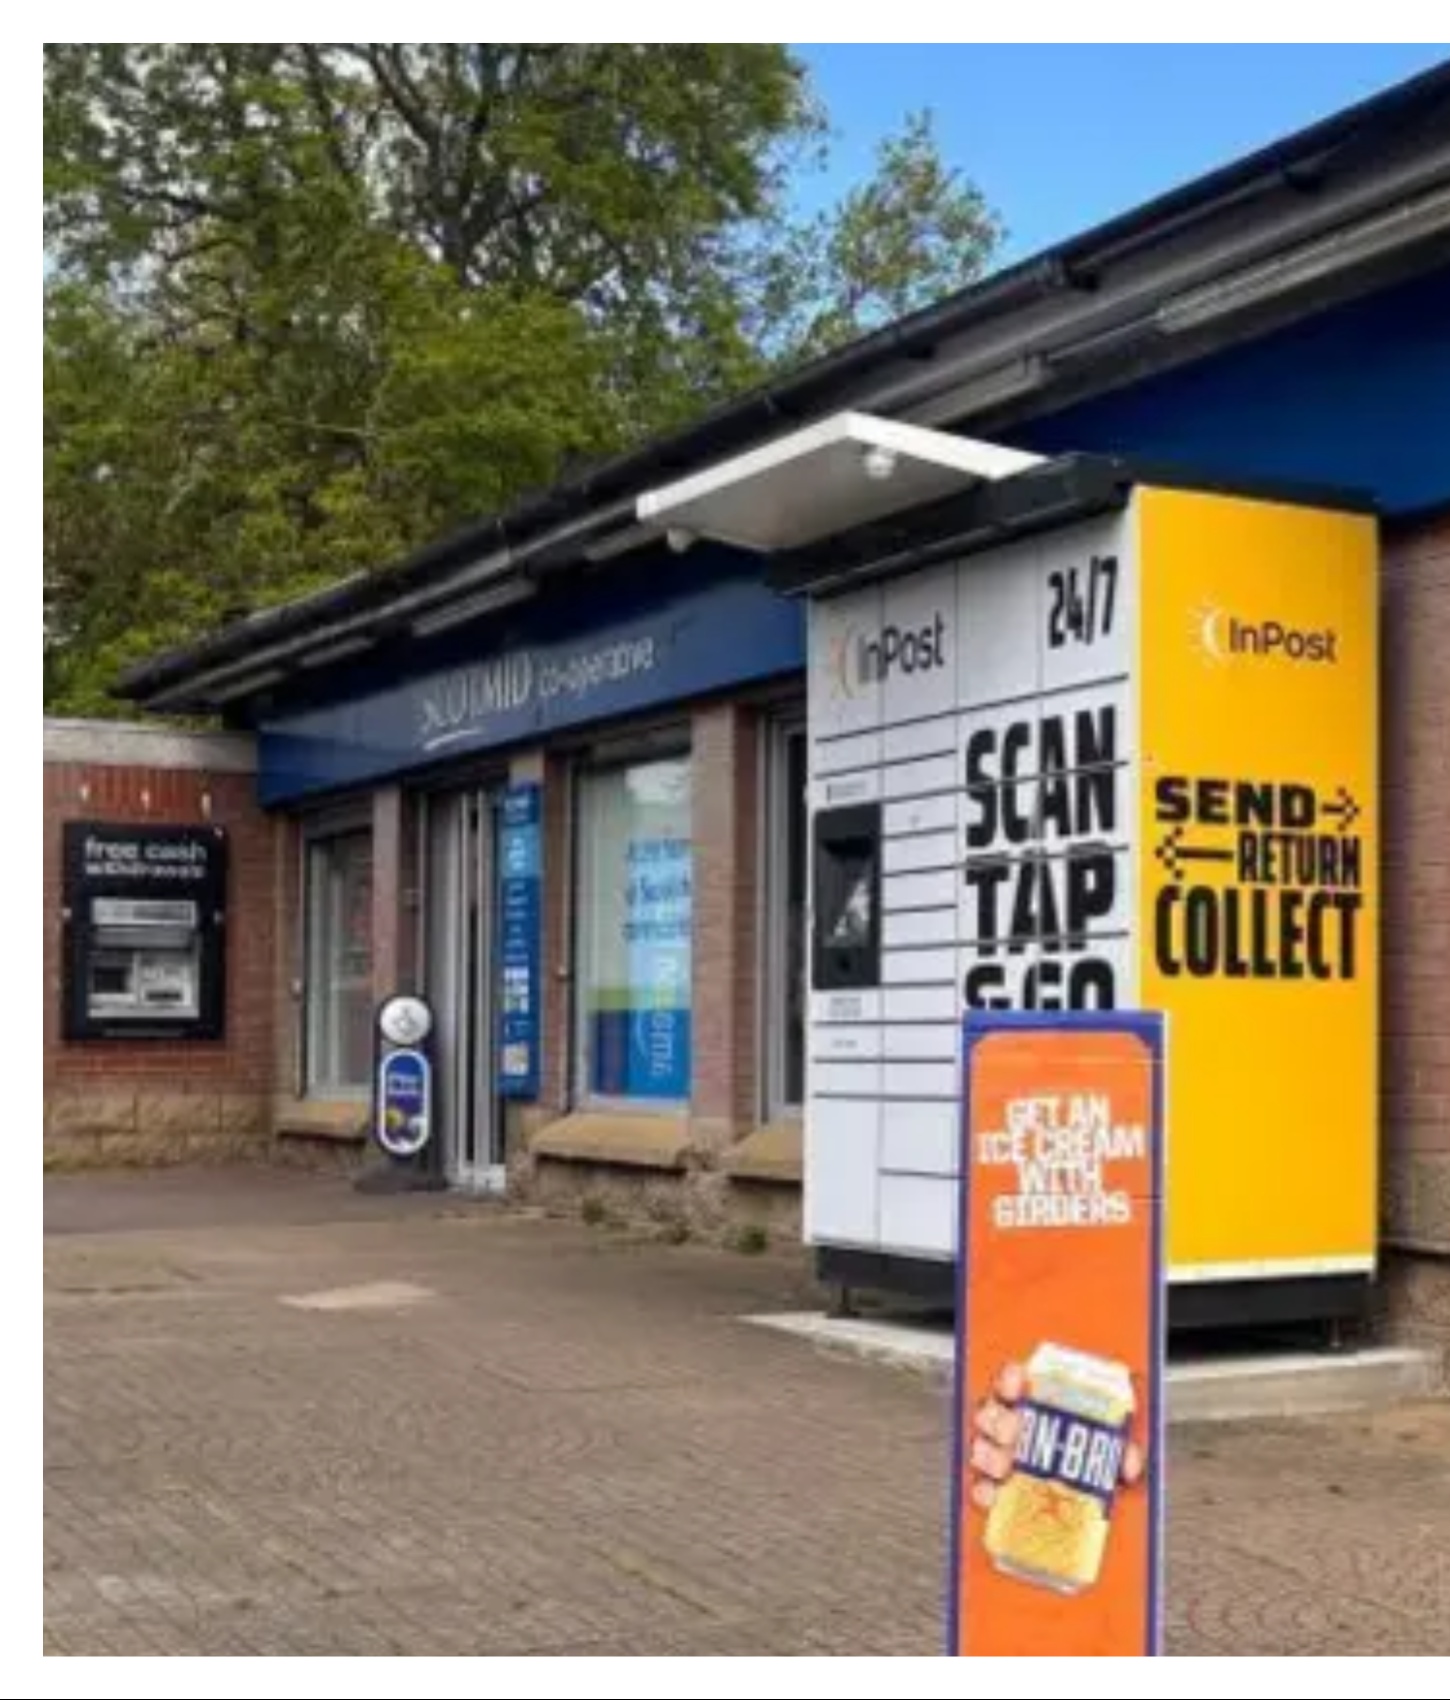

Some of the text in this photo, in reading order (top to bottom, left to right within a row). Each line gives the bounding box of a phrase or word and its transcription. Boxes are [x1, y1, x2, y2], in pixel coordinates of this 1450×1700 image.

[1047, 554, 1119, 650] 24/7
[856, 611, 945, 684] InPost
[1228, 619, 1337, 664] InPost
[964, 704, 1118, 849] SCAN
[1154, 775, 1317, 829] SEND
[85, 834, 208, 862] free cash
[1236, 831, 1361, 888] RETURN
[964, 842, 1117, 958] TAP
[1154, 883, 1363, 980] COLLECT
[1005, 1092, 1111, 1134] GET AN
[978, 1125, 1144, 1165] ICE CREAM
[1017, 1160, 1104, 1196] WITH
[992, 1192, 1131, 1228] GIRDERS
